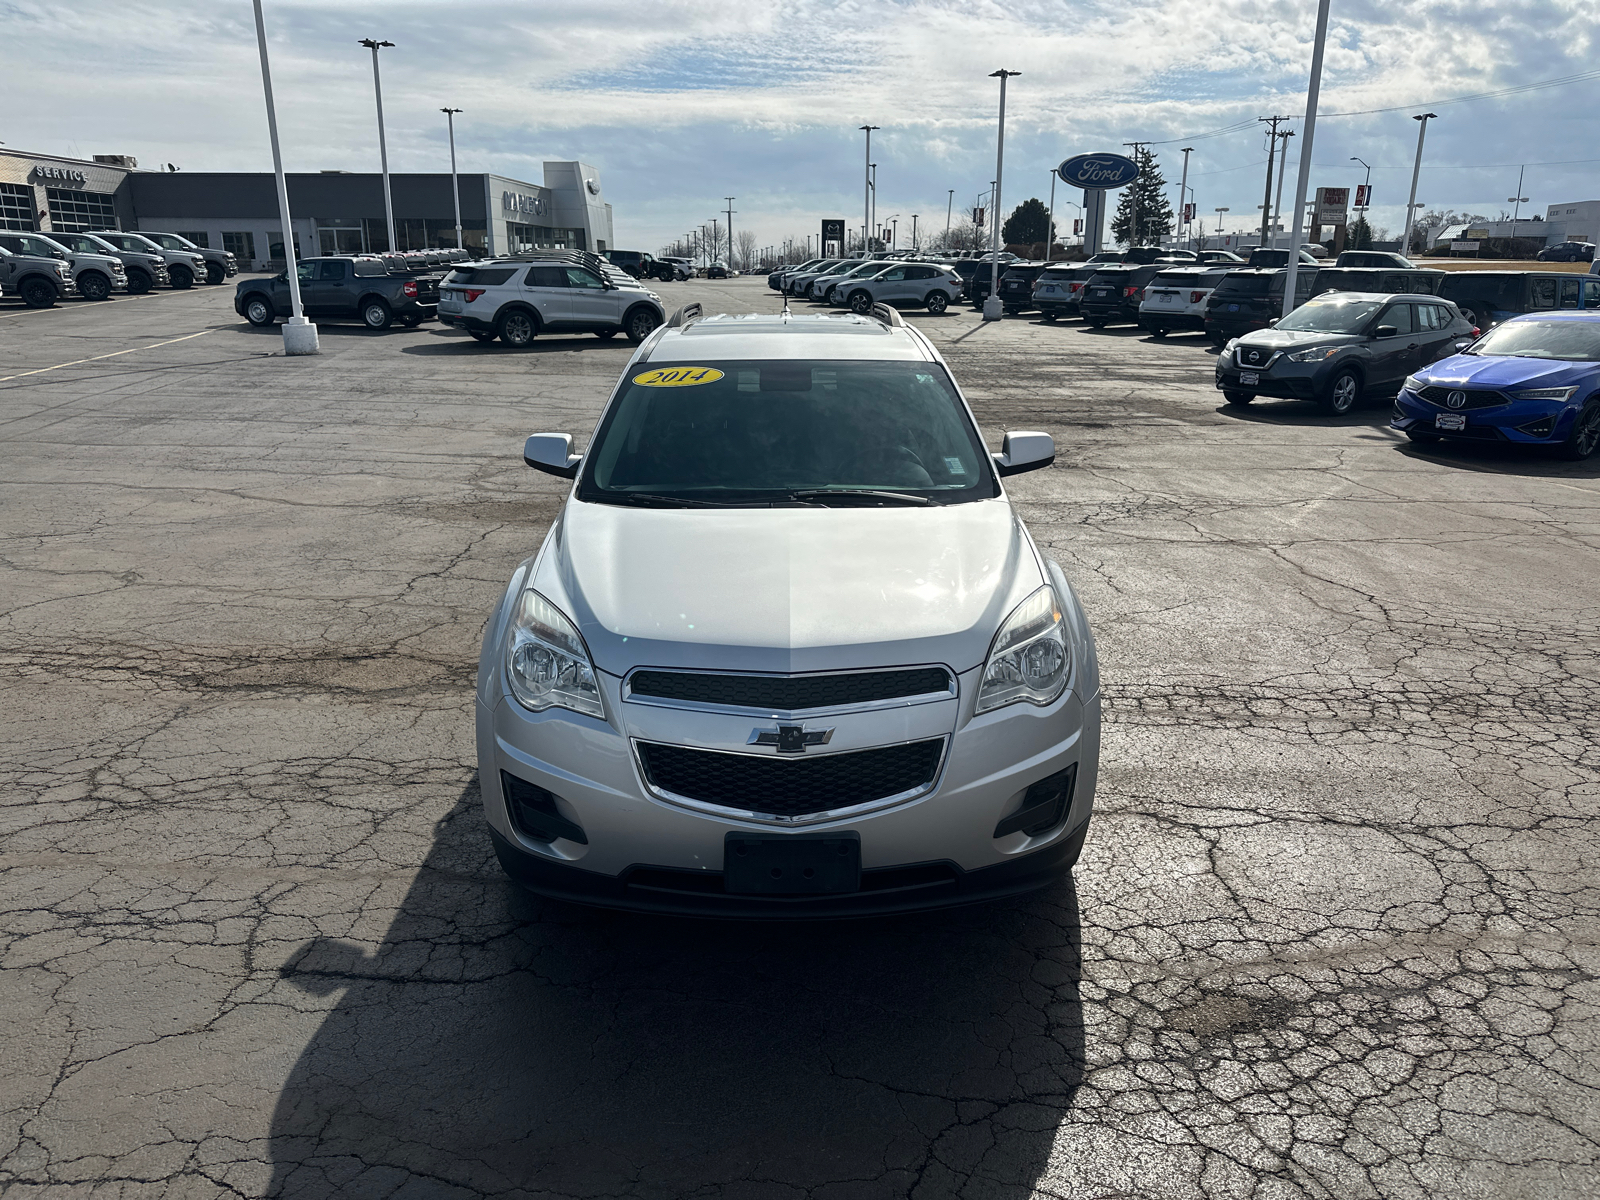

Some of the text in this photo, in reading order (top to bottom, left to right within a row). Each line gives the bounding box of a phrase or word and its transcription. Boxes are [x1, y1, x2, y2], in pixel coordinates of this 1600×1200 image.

[36, 166, 88, 182] SERVICE
[1078, 160, 1124, 180] Ford
[645, 369, 710, 384] 2014
